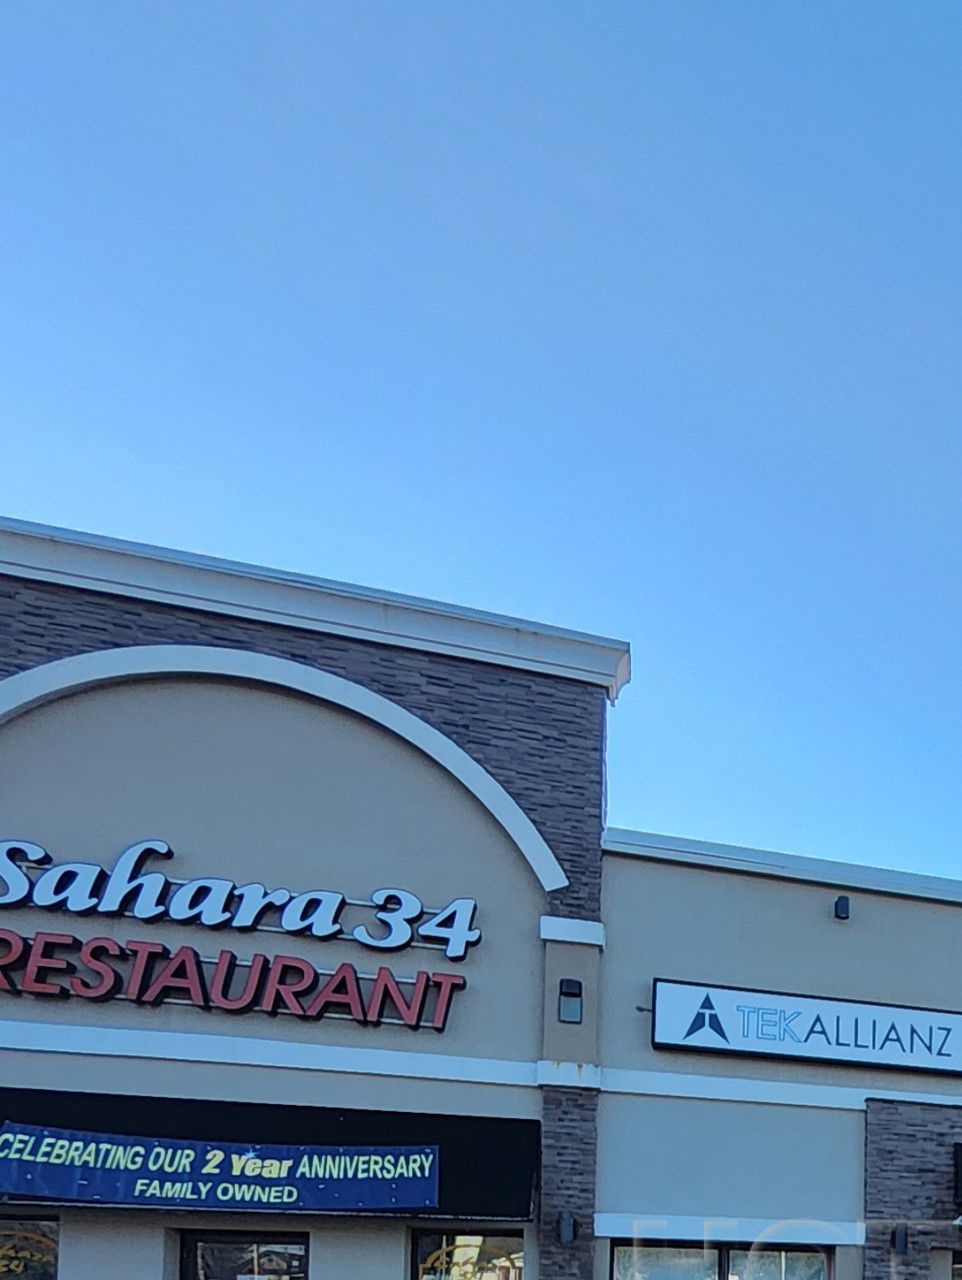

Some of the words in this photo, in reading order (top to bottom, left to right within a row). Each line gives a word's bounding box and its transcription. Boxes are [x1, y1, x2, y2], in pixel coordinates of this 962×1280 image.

[0, 838, 343, 938] Sahara
[353, 887, 481, 960] 34
[0, 928, 467, 1032] RESTAURANT
[0, 1132, 146, 1171] CELEBRATING
[147, 1146, 196, 1174] OUR
[201, 1149, 226, 1175] 2
[230, 1153, 294, 1179] Year
[295, 1153, 434, 1180] ANNIVERSARY
[133, 1178, 214, 1201] FAMILY
[215, 1182, 299, 1204] OWNED
